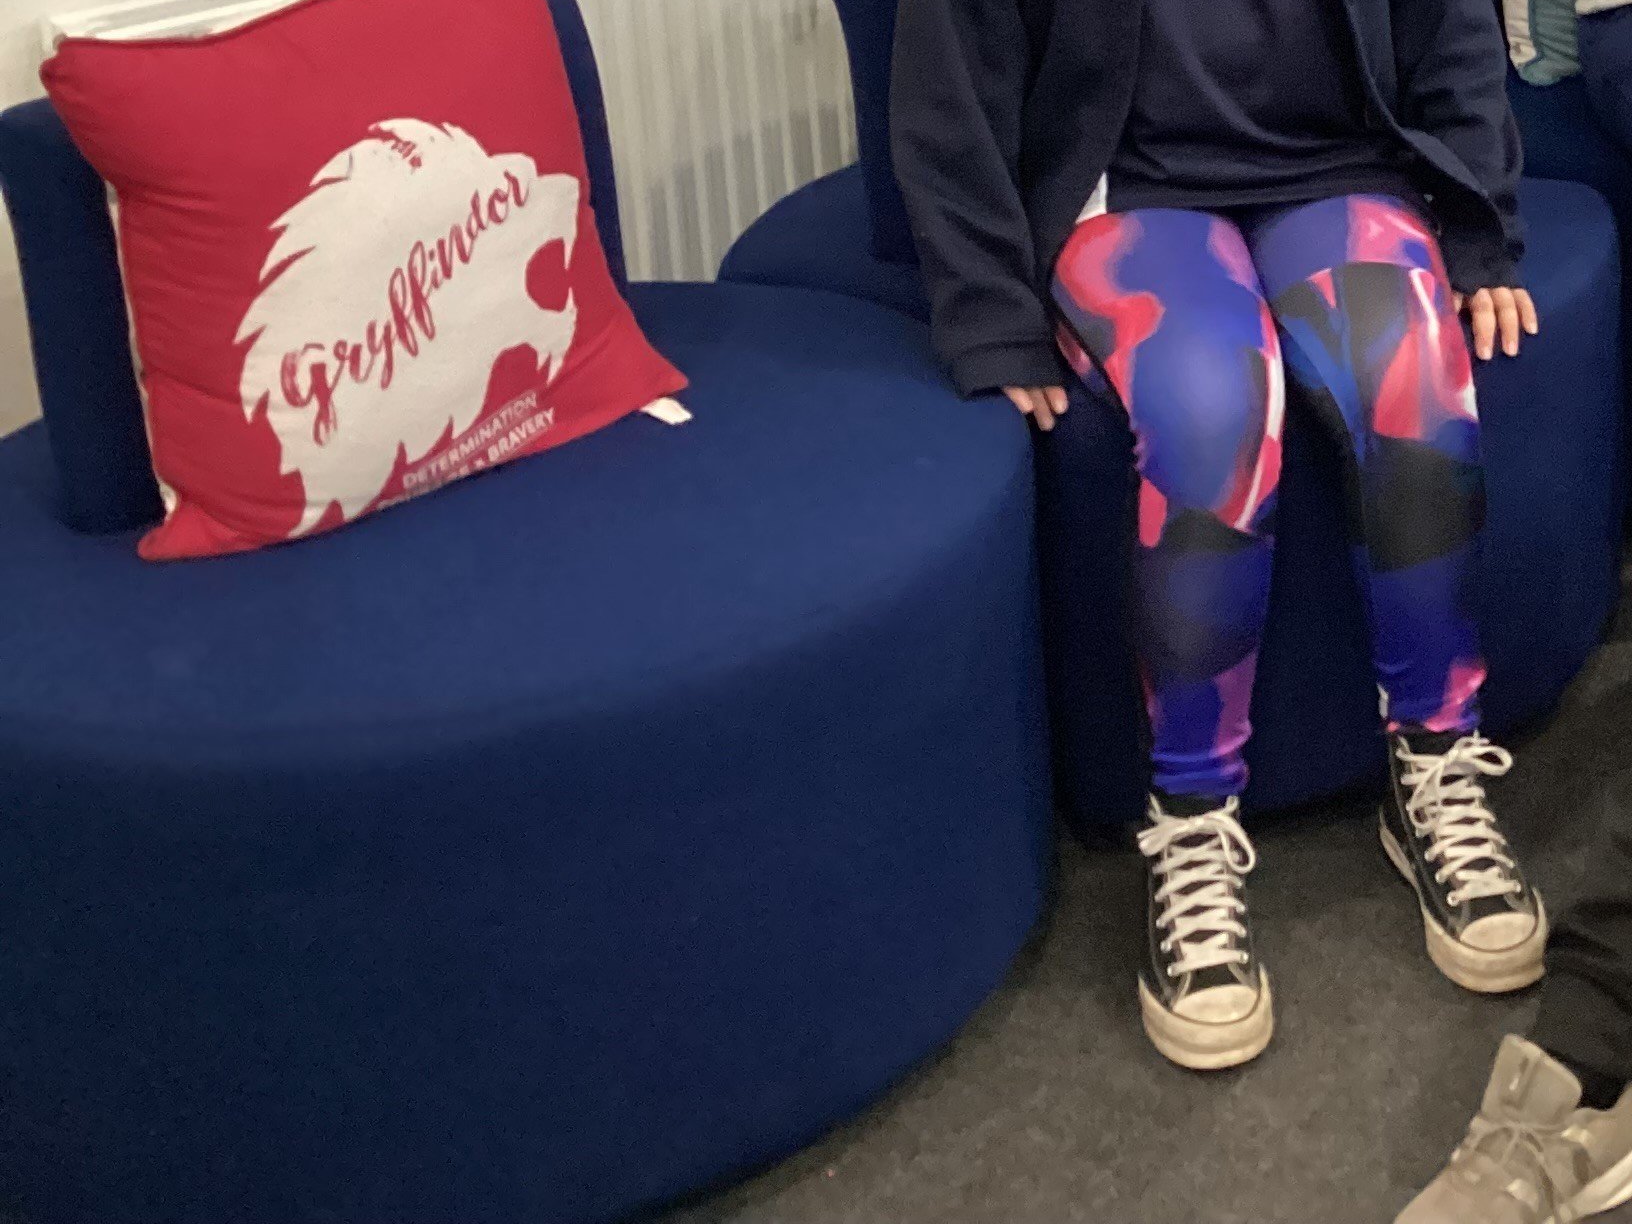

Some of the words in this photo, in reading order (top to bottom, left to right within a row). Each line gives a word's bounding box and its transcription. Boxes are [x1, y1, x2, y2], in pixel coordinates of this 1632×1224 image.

[280, 168, 531, 448] Gryffindor
[402, 391, 539, 490] DETERMINATION
[486, 406, 555, 463] BRAVERY
